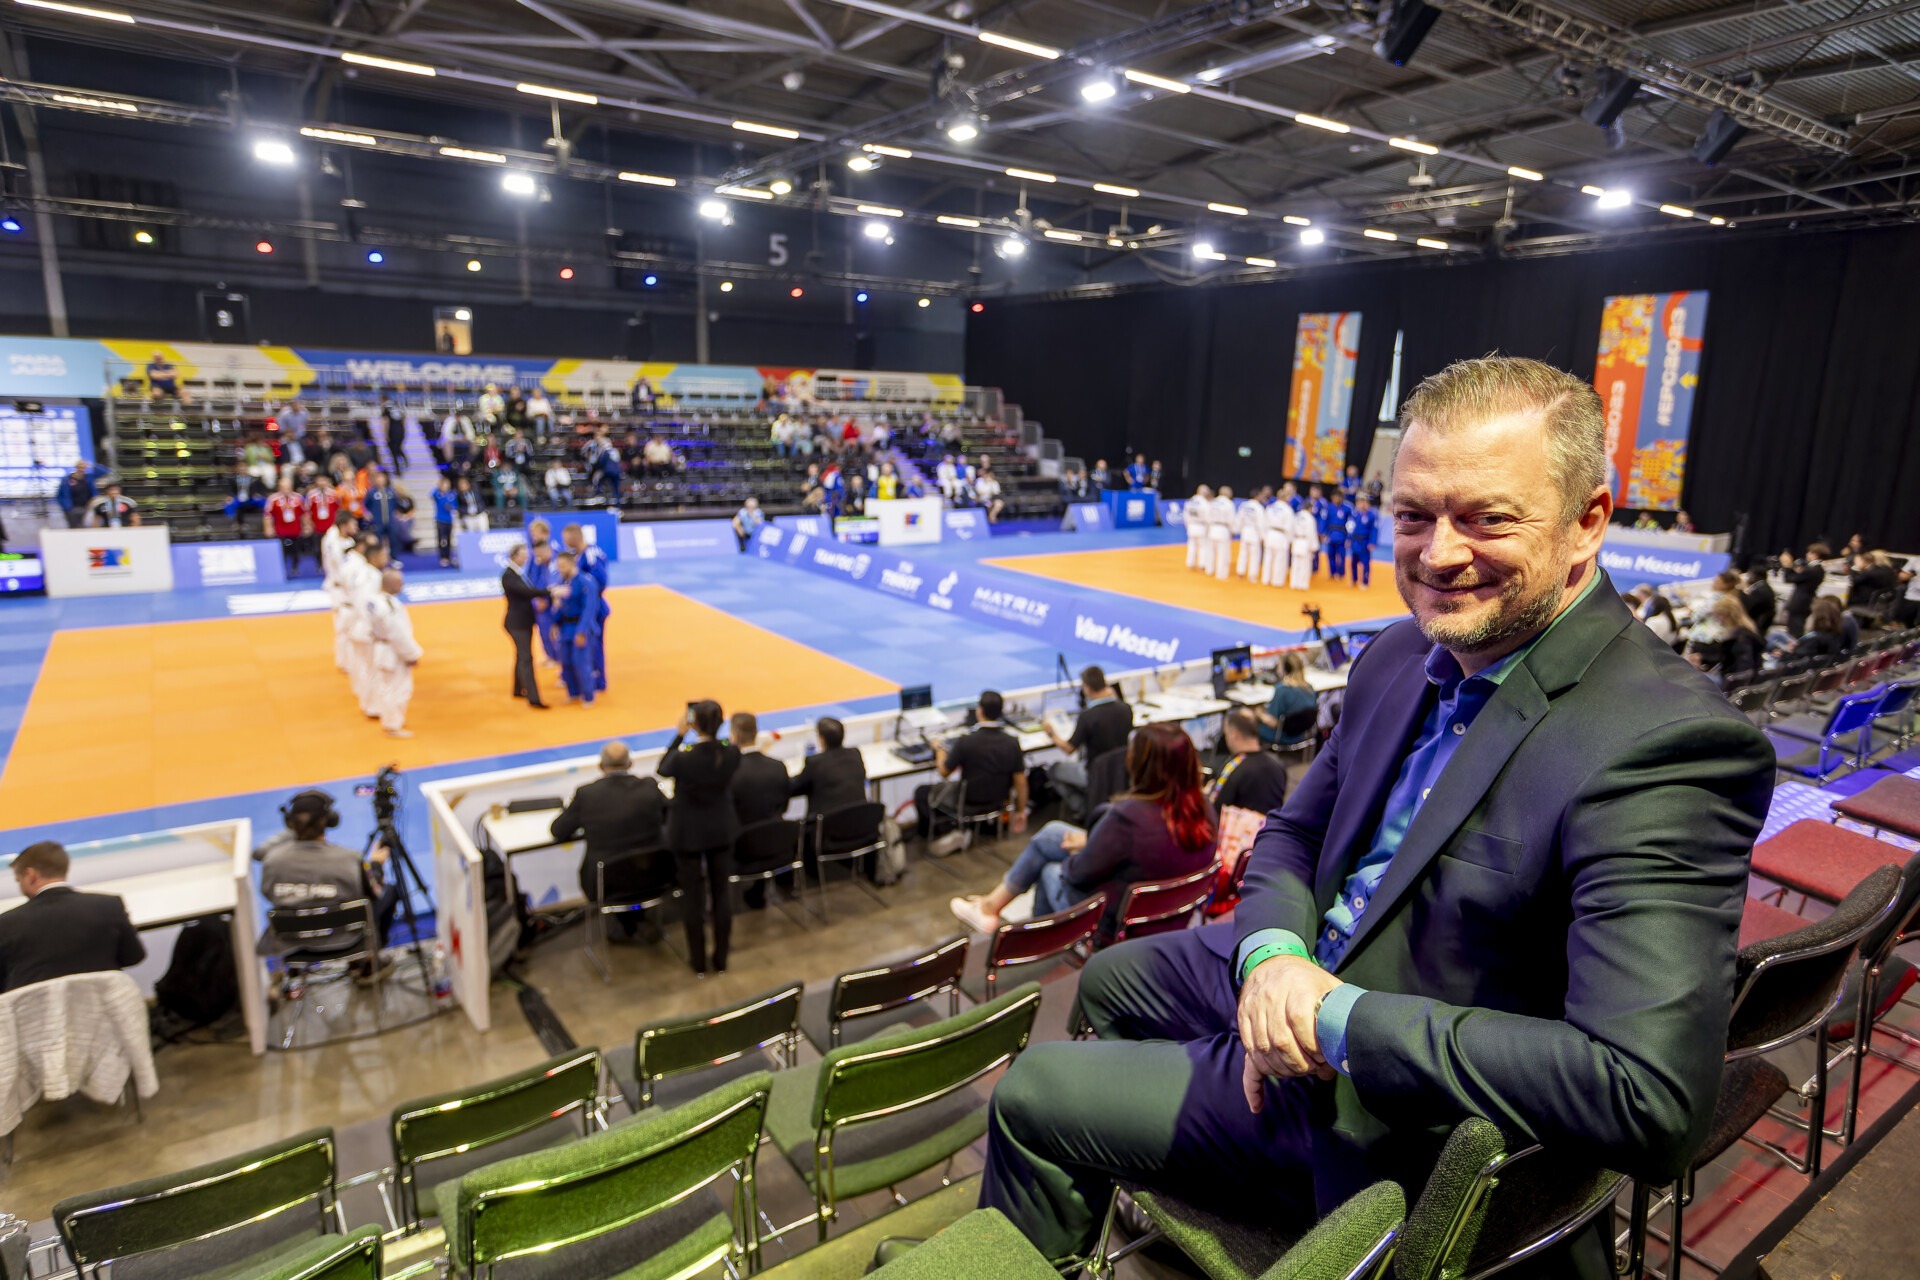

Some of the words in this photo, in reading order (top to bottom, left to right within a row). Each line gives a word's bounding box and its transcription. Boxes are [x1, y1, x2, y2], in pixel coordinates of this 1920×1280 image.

[769, 233, 788, 266] 5
[346, 359, 515, 384] WELCOME
[1656, 306, 1687, 426] #EPC2023
[1601, 551, 1633, 571] Van
[1633, 555, 1701, 578] Mossel
[974, 586, 1050, 619] MATRIX
[1074, 613, 1109, 645] Van
[1106, 623, 1180, 664] Mossel
